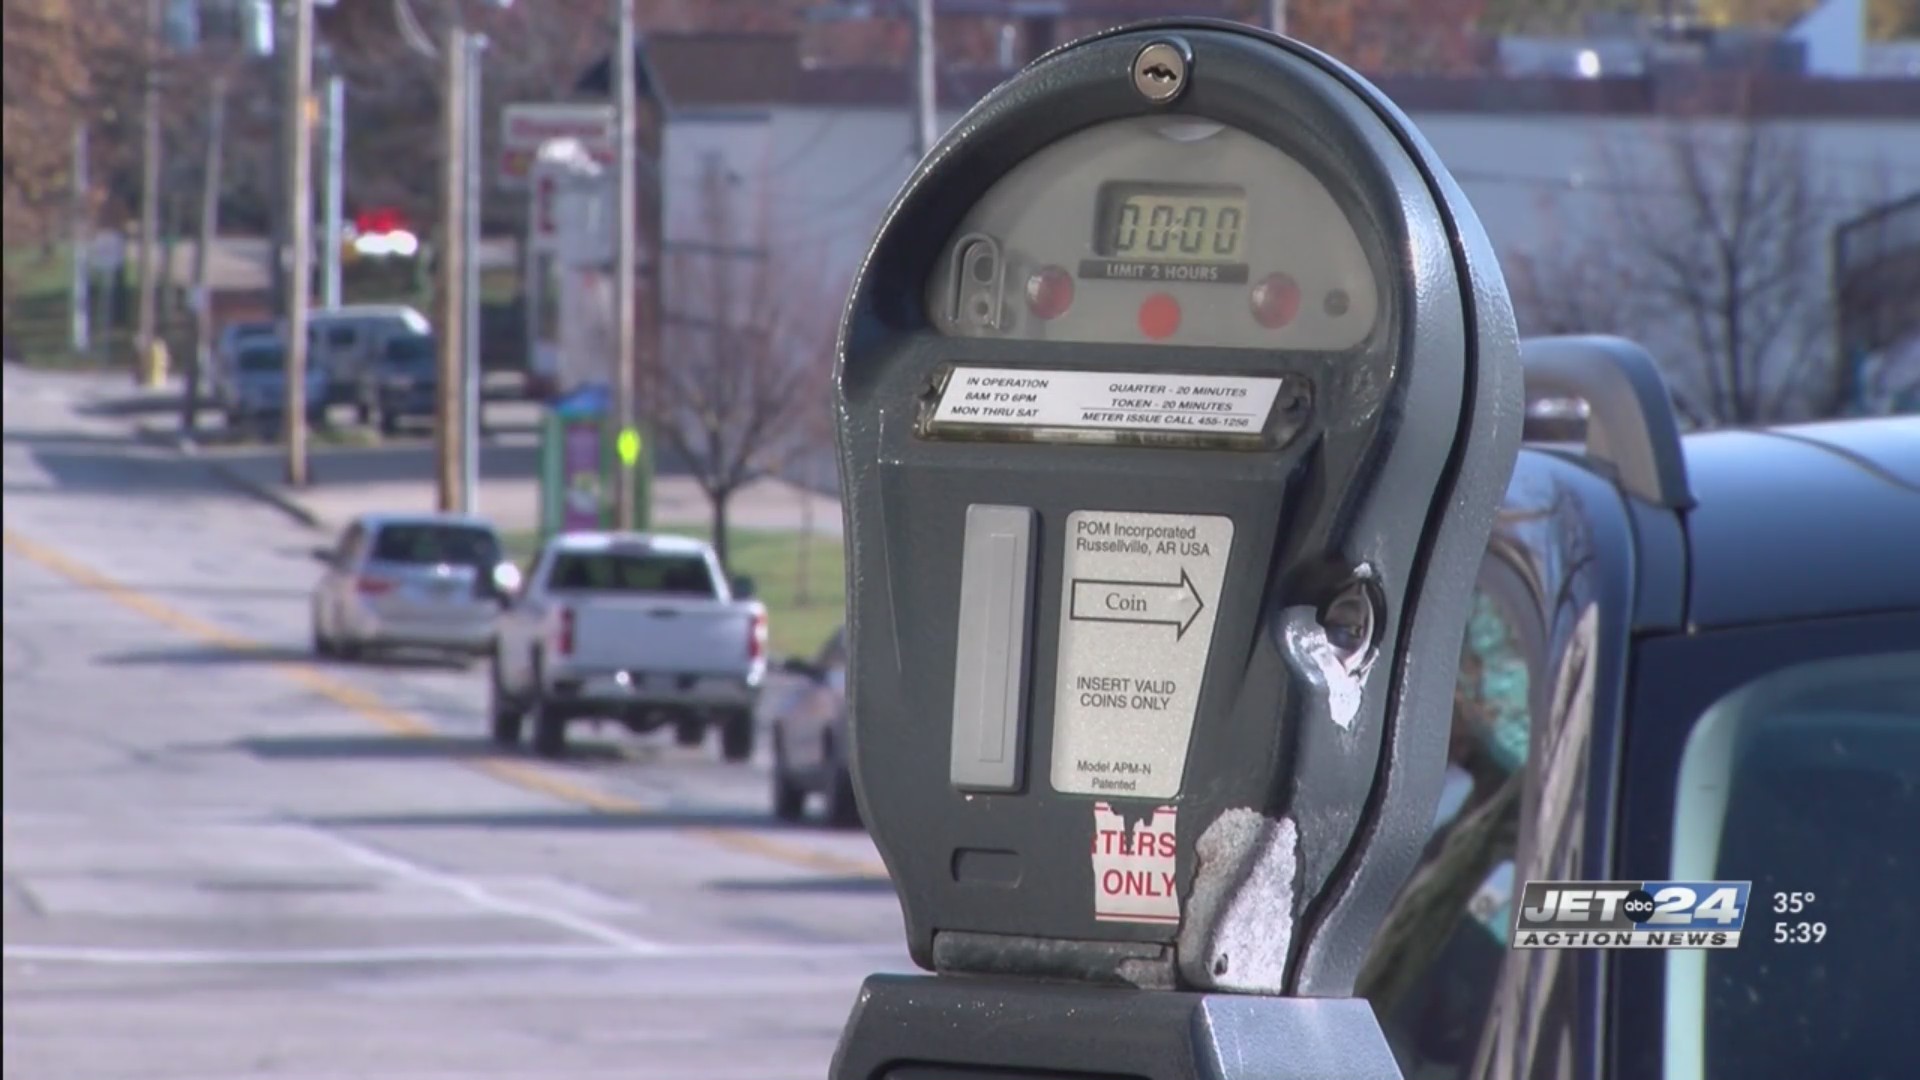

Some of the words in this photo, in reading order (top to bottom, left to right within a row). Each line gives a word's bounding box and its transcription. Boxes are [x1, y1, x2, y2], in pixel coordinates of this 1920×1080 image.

[1114, 203, 1241, 254] 00:00
[1106, 264, 1145, 278] LIMIT
[1150, 266, 1160, 279] 2
[1165, 266, 1218, 280] HOURS
[966, 377, 979, 386] IN
[982, 378, 1049, 388] OPERATION
[1109, 383, 1166, 394] QUARTER
[1176, 386, 1191, 395] 20
[1192, 386, 1247, 397] MINUTES
[994, 392, 1010, 402] TO
[1011, 394, 1037, 403] 6PM
[1111, 398, 1152, 408] TOKEN
[1162, 400, 1176, 409] 20
[1178, 401, 1233, 411] MINUTES
[951, 406, 979, 416] MON
[982, 407, 1014, 417] THRU
[1016, 408, 1039, 417] SAT
[1082, 412, 1124, 422] METER
[1126, 413, 1162, 424] ISSUE
[1164, 415, 1194, 425] CALL
[1077, 521, 1110, 535] POM
[1114, 522, 1196, 540] Incorporated
[1076, 537, 1152, 555] Russellville,
[1156, 541, 1176, 554] AR
[1180, 542, 1210, 556] USA
[1105, 592, 1147, 611] Coin
[1077, 676, 1130, 692] INSERT
[1135, 679, 1176, 695] VALID
[1080, 693, 1127, 709] COINS
[1131, 696, 1170, 710] ONLY
[1077, 760, 1110, 772] Model
[1112, 762, 1151, 775] APM-N
[1091, 777, 1136, 791] Patented
[1103, 869, 1176, 897] ONLY
